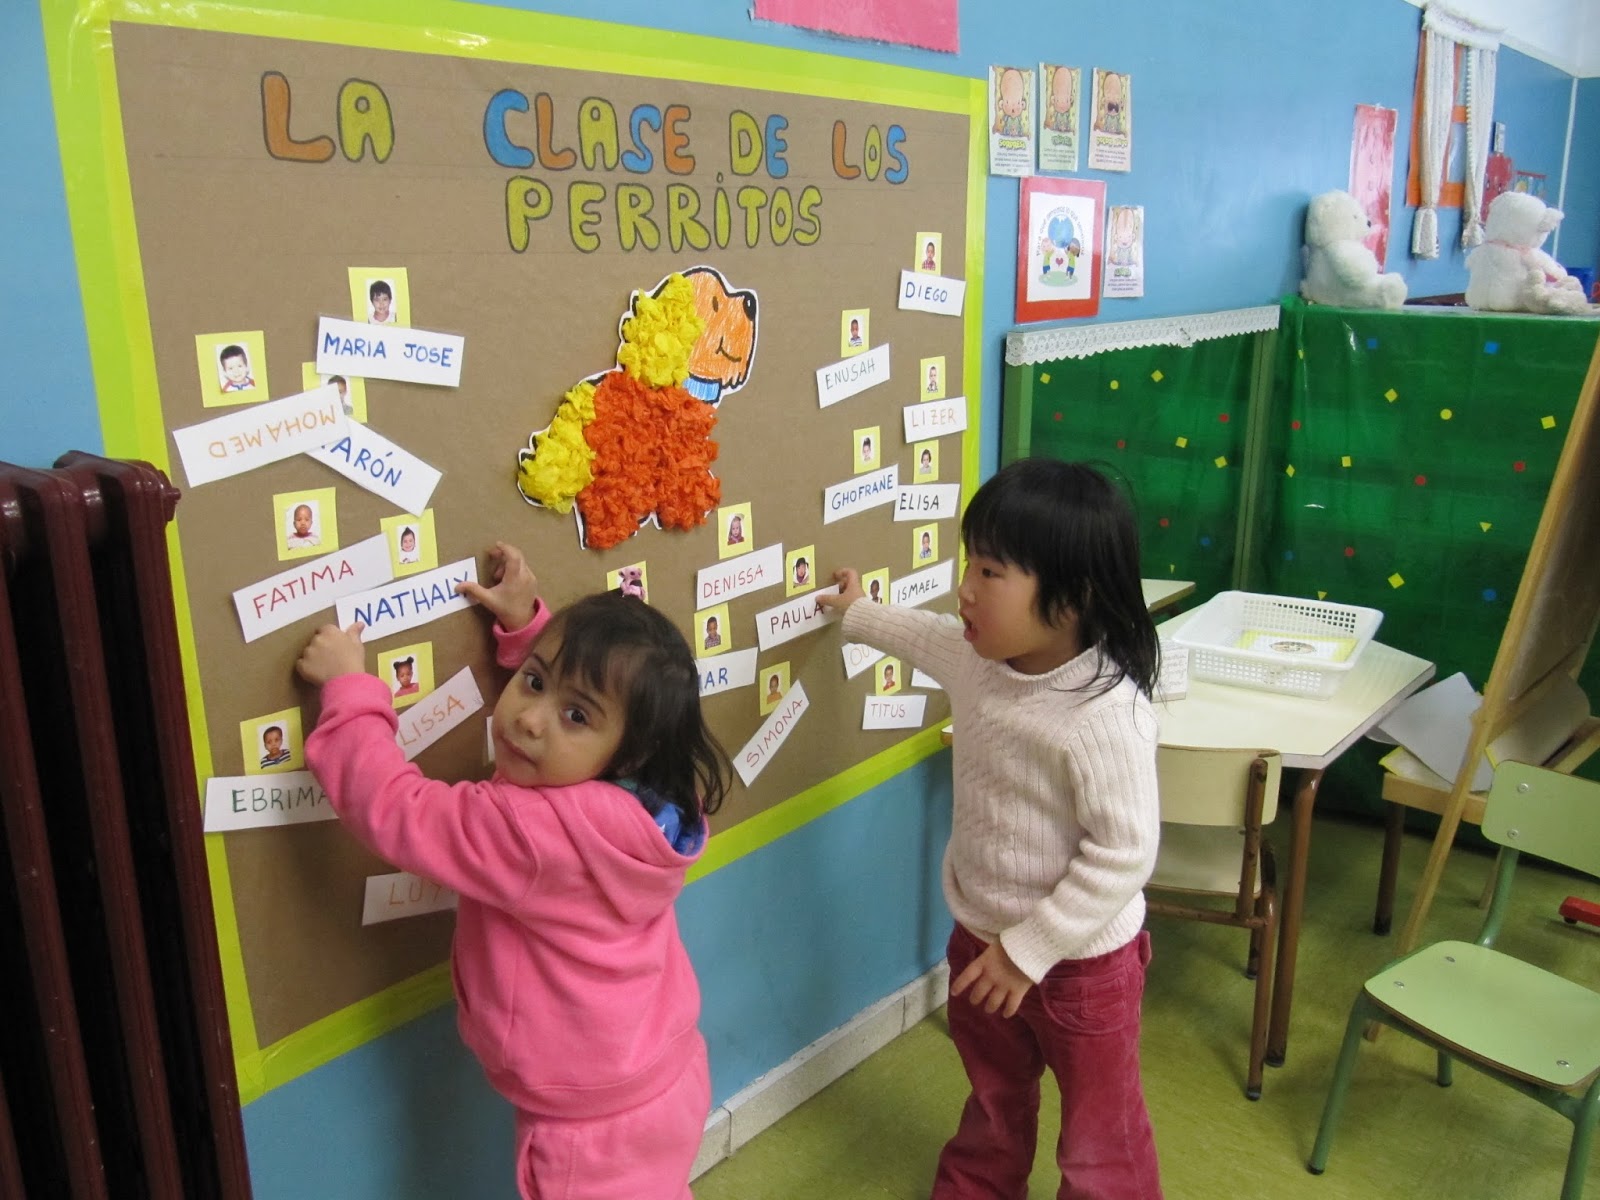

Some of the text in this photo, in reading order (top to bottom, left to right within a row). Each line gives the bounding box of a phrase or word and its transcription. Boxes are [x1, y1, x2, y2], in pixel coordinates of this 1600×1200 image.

[260, 70, 909, 184] LA CLASE DE LOS
[905, 281, 948, 303] DIEGO
[322, 332, 454, 368] MARIA JOSE
[825, 360, 876, 390] ENUSAH
[208, 405, 337, 459] MOHAMED
[911, 407, 957, 428] LIZER
[321, 436, 403, 488] ARÓN
[831, 473, 894, 511] GHOFRANE
[899, 492, 940, 511] ELISA
[252, 559, 354, 619] FATIMA
[354, 571, 468, 627] NATHALY
[702, 564, 764, 599] DENISSA
[897, 578, 939, 603] ISMAEL
[769, 601, 825, 635] PAULA
[850, 644, 874, 666] OU
[870, 703, 906, 718] TITUS
[746, 699, 803, 768] SIMONA
